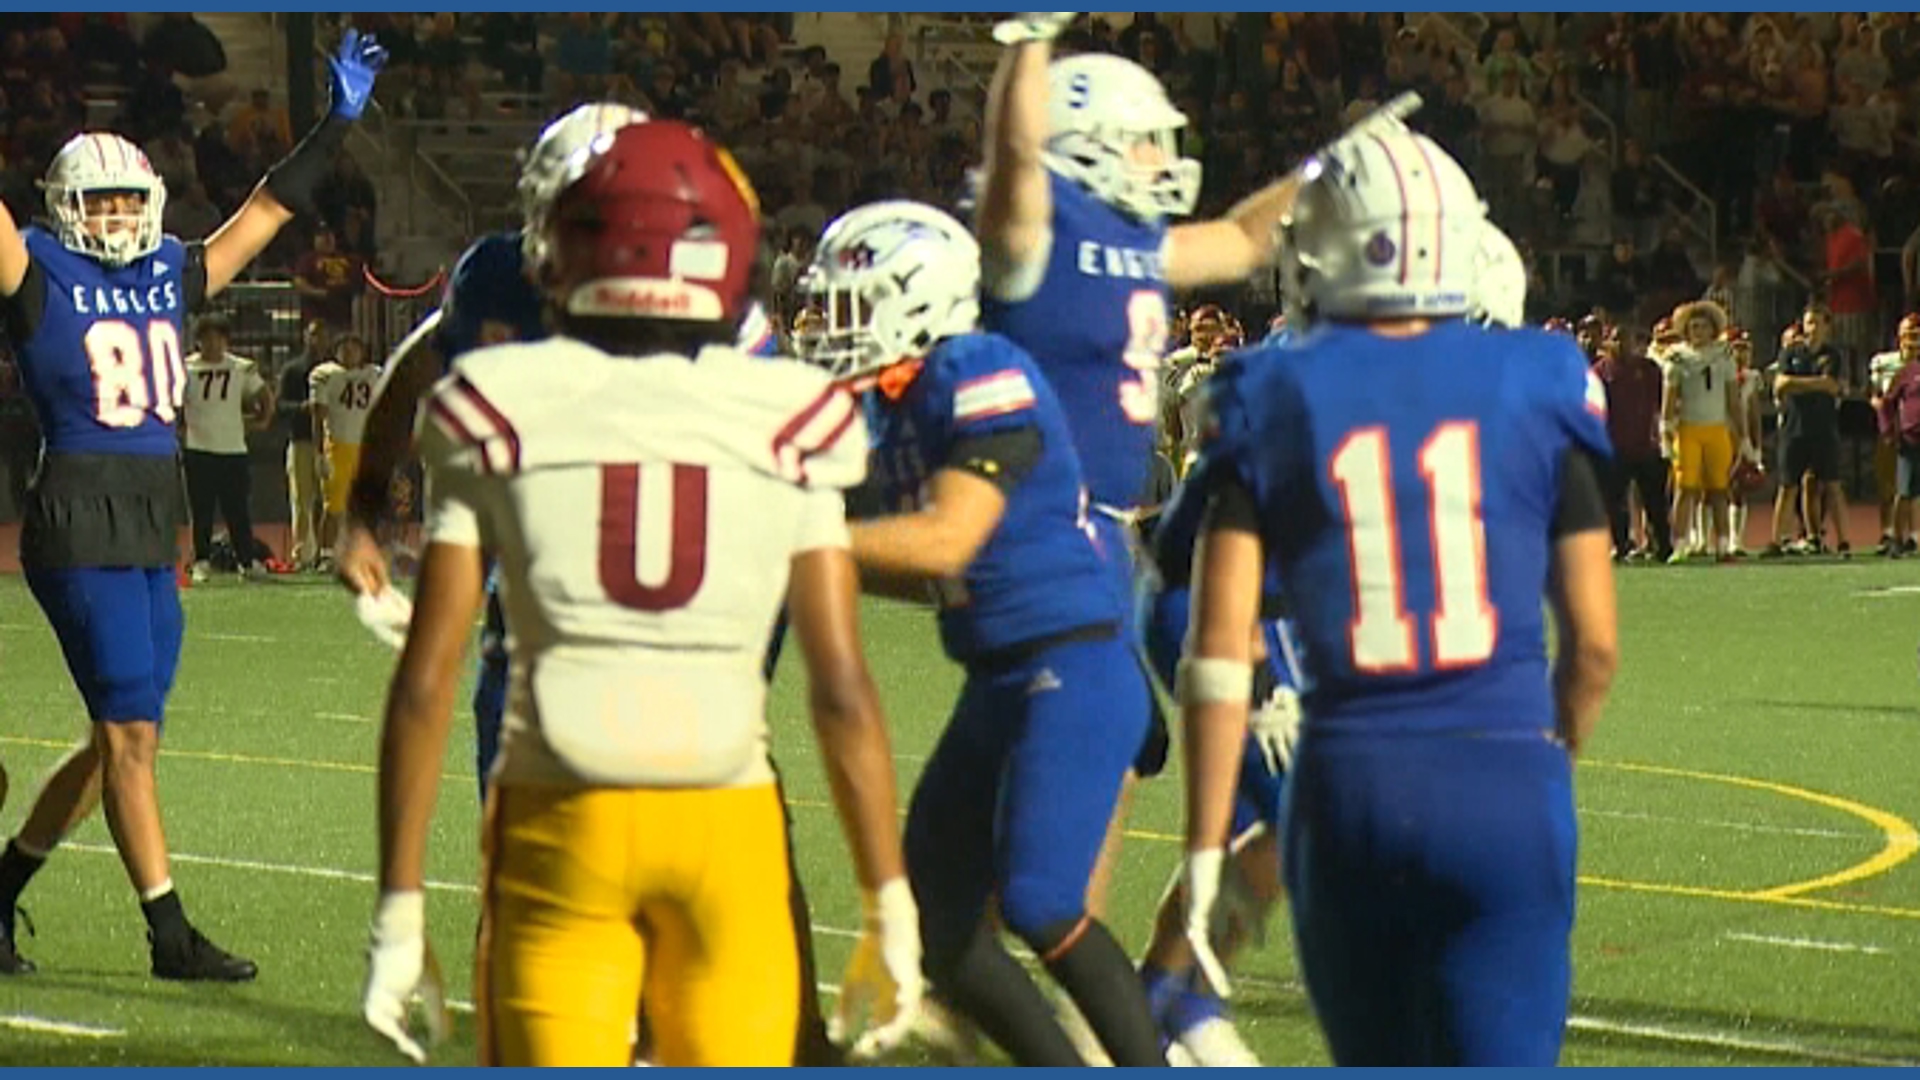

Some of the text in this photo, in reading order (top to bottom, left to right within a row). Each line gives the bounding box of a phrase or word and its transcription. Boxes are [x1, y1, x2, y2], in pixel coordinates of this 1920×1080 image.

[72, 281, 177, 314] EAGLES
[85, 318, 187, 427] 80
[199, 369, 231, 401] 77
[1701, 365, 1711, 391] 1
[340, 381, 371, 411] 43
[1328, 418, 1500, 674] 11
